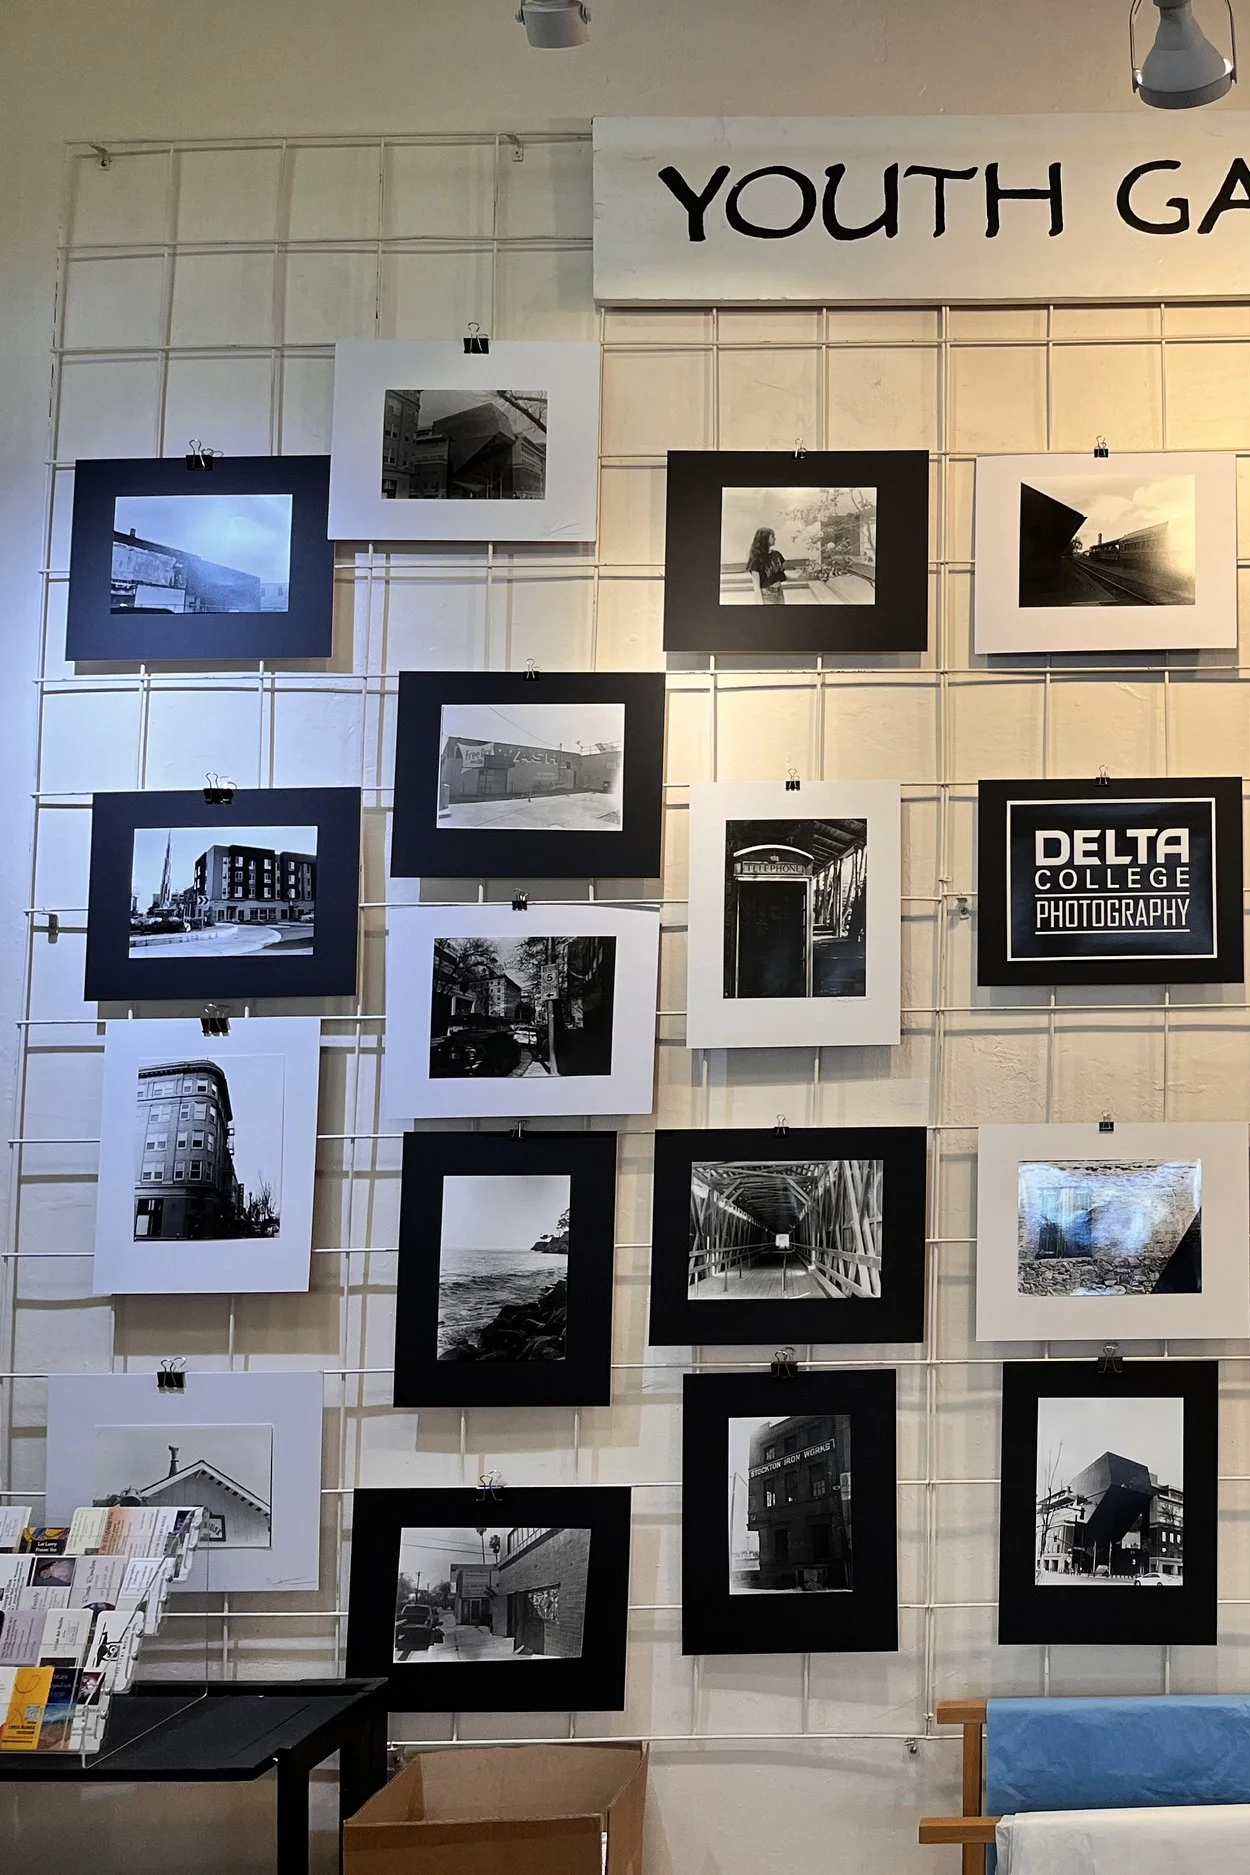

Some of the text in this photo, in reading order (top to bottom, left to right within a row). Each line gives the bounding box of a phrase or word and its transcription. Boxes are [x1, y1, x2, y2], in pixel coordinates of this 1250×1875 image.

[658, 163, 1063, 242] YOUTH
[1035, 828, 1190, 866] DELTA
[747, 864, 802, 873] TELEPHONE
[1035, 867, 1190, 890] COLLEGE
[1036, 898, 1190, 928] PHOTOGRAPHY
[750, 1442, 831, 1478] STOCKTON IRON WORKS
